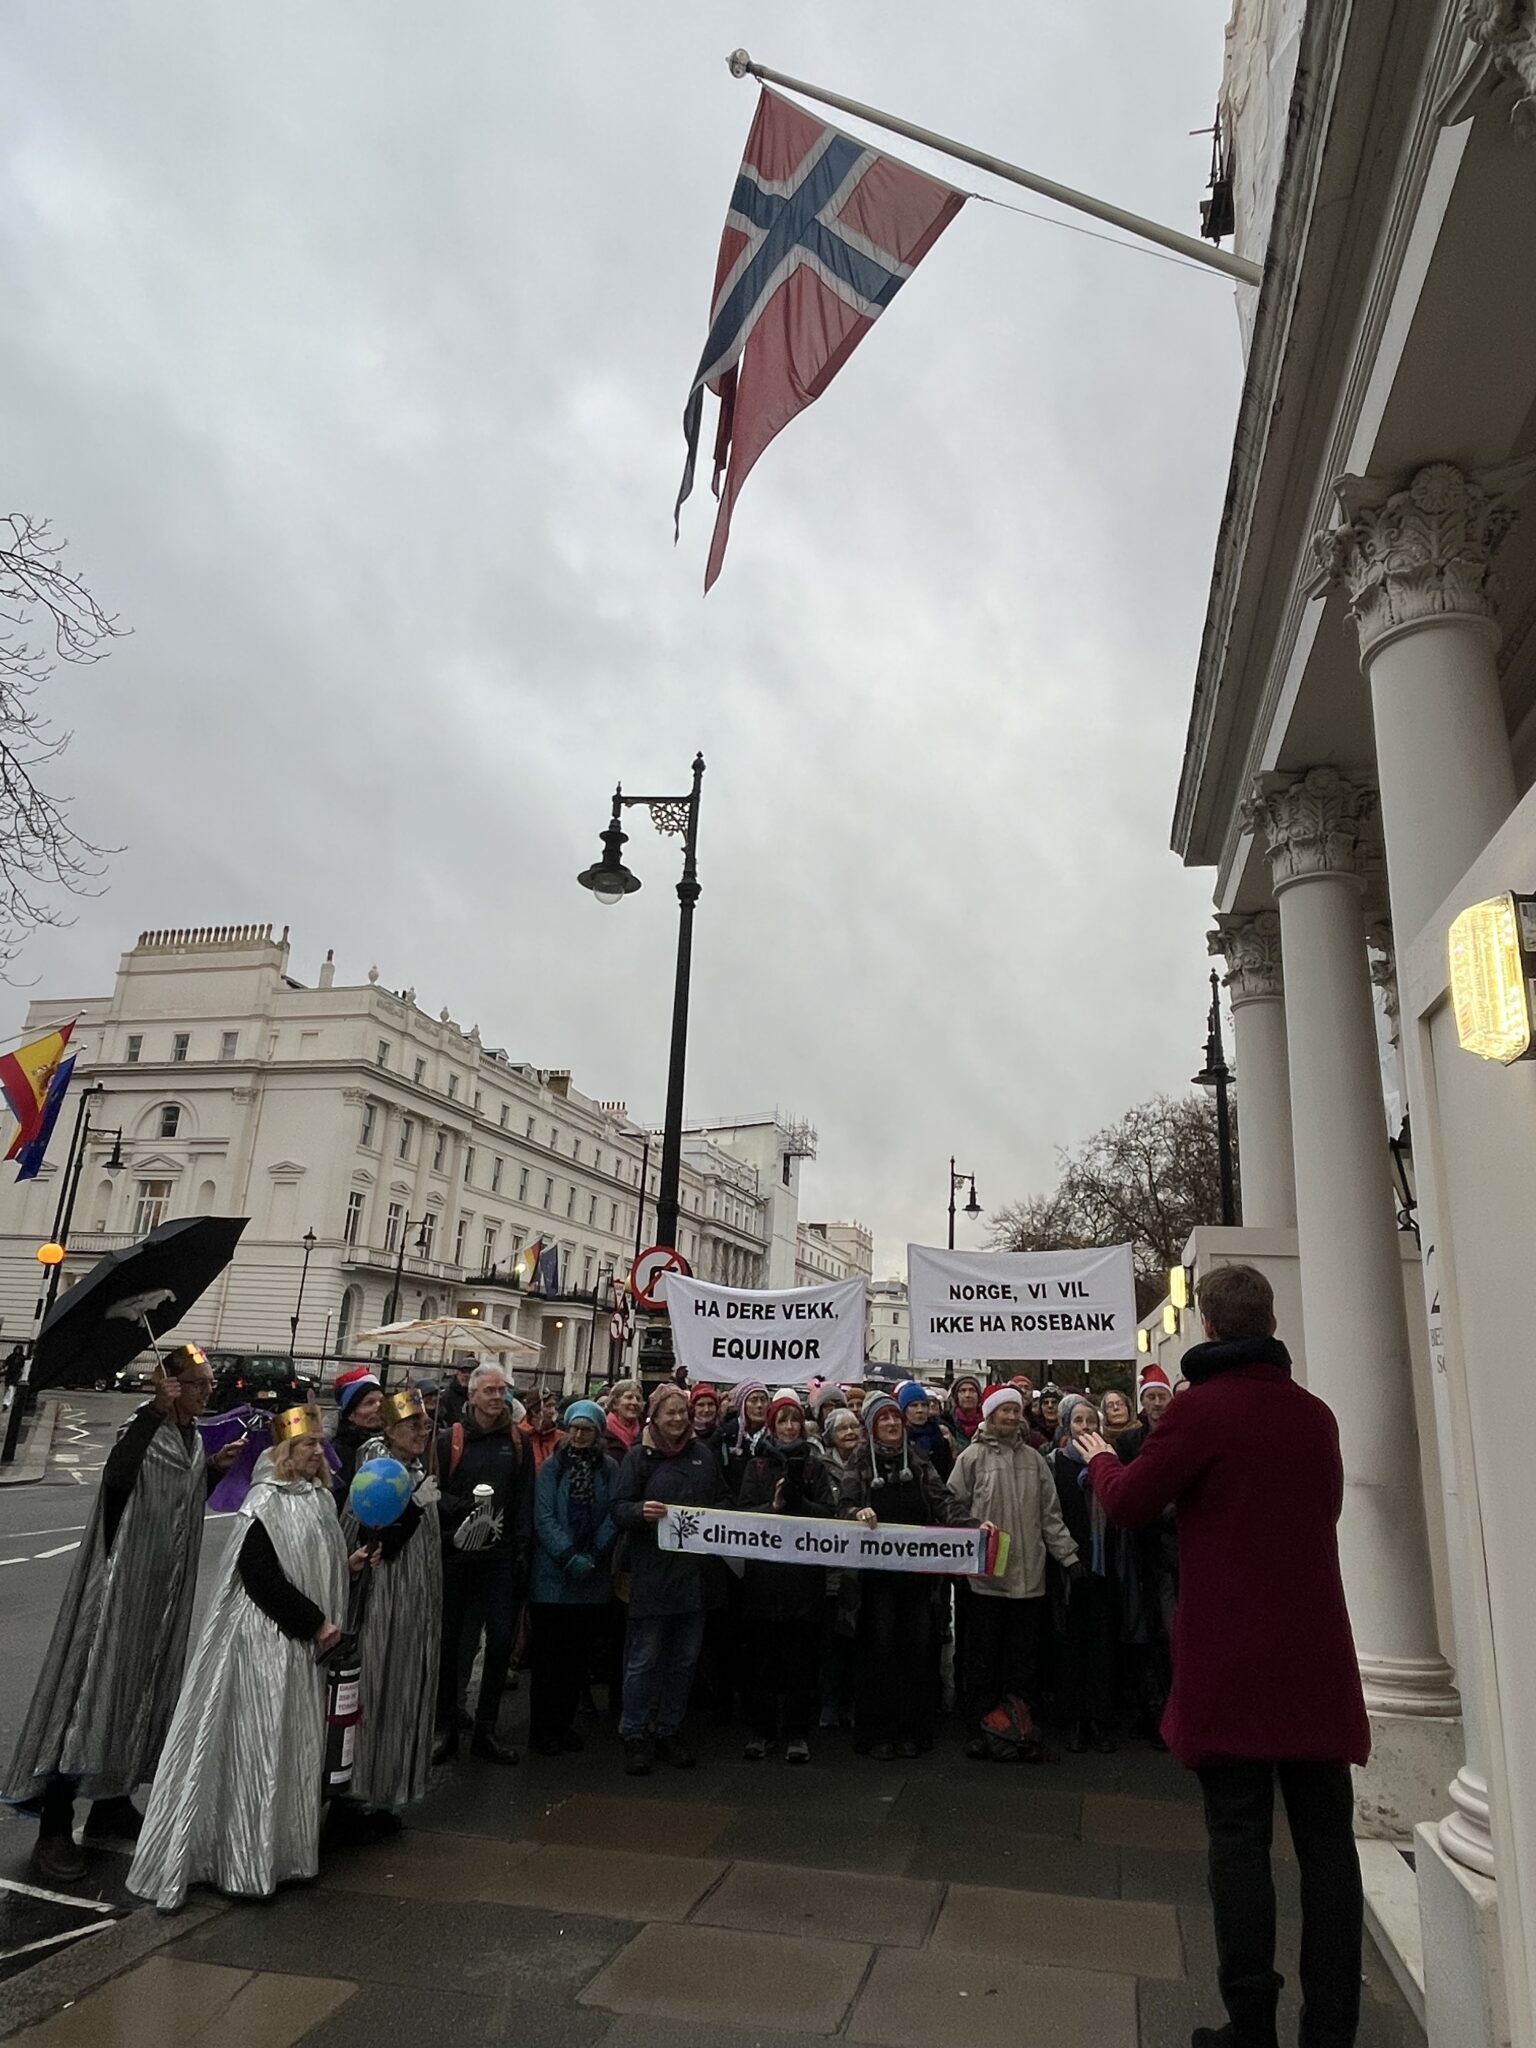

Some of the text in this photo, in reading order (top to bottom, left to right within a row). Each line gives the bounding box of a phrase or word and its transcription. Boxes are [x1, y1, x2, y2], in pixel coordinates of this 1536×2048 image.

[949, 1281, 1090, 1303] NORGE, VI VIL
[694, 1299, 839, 1320] HA DERE VEKK,
[930, 1313, 1116, 1333] IKKE HA ROSEBANK
[712, 1337, 820, 1360] EQUINOR
[702, 1524, 975, 1558] climate choir movement
